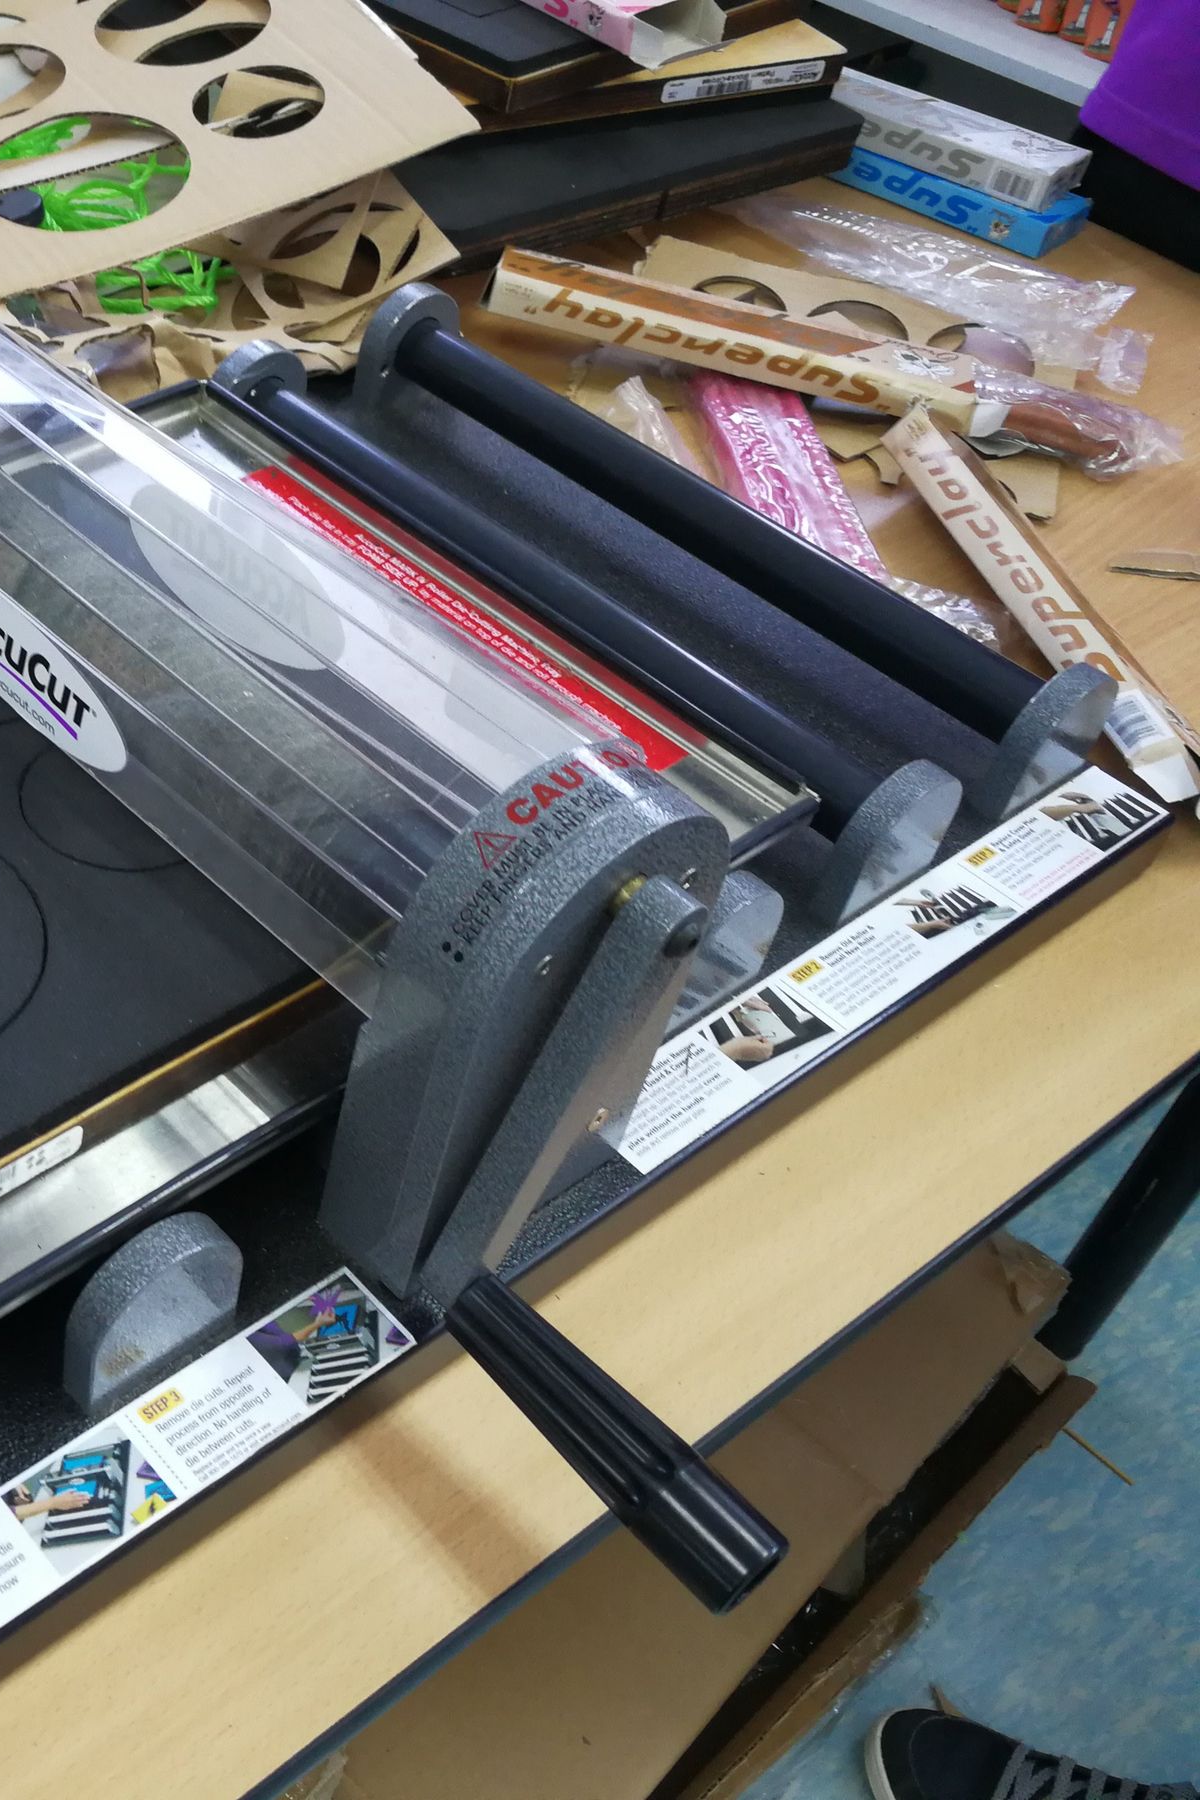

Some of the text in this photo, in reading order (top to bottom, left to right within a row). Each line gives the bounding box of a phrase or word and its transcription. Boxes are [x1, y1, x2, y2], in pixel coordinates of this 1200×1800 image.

[355, 544, 386, 564] FOAM
[506, 751, 631, 826] CAUTIO
[553, 812, 587, 841] AND
[791, 964, 813, 983] STEP
[645, 1117, 672, 1139] without
[141, 1390, 180, 1419] STEP 3
[154, 1364, 255, 1433] Remove die cuts. Repeat
[165, 1383, 255, 1446] process from opposite
[174, 1387, 272, 1456] direction. No handling of
[184, 1416, 256, 1467] die between cuts.
